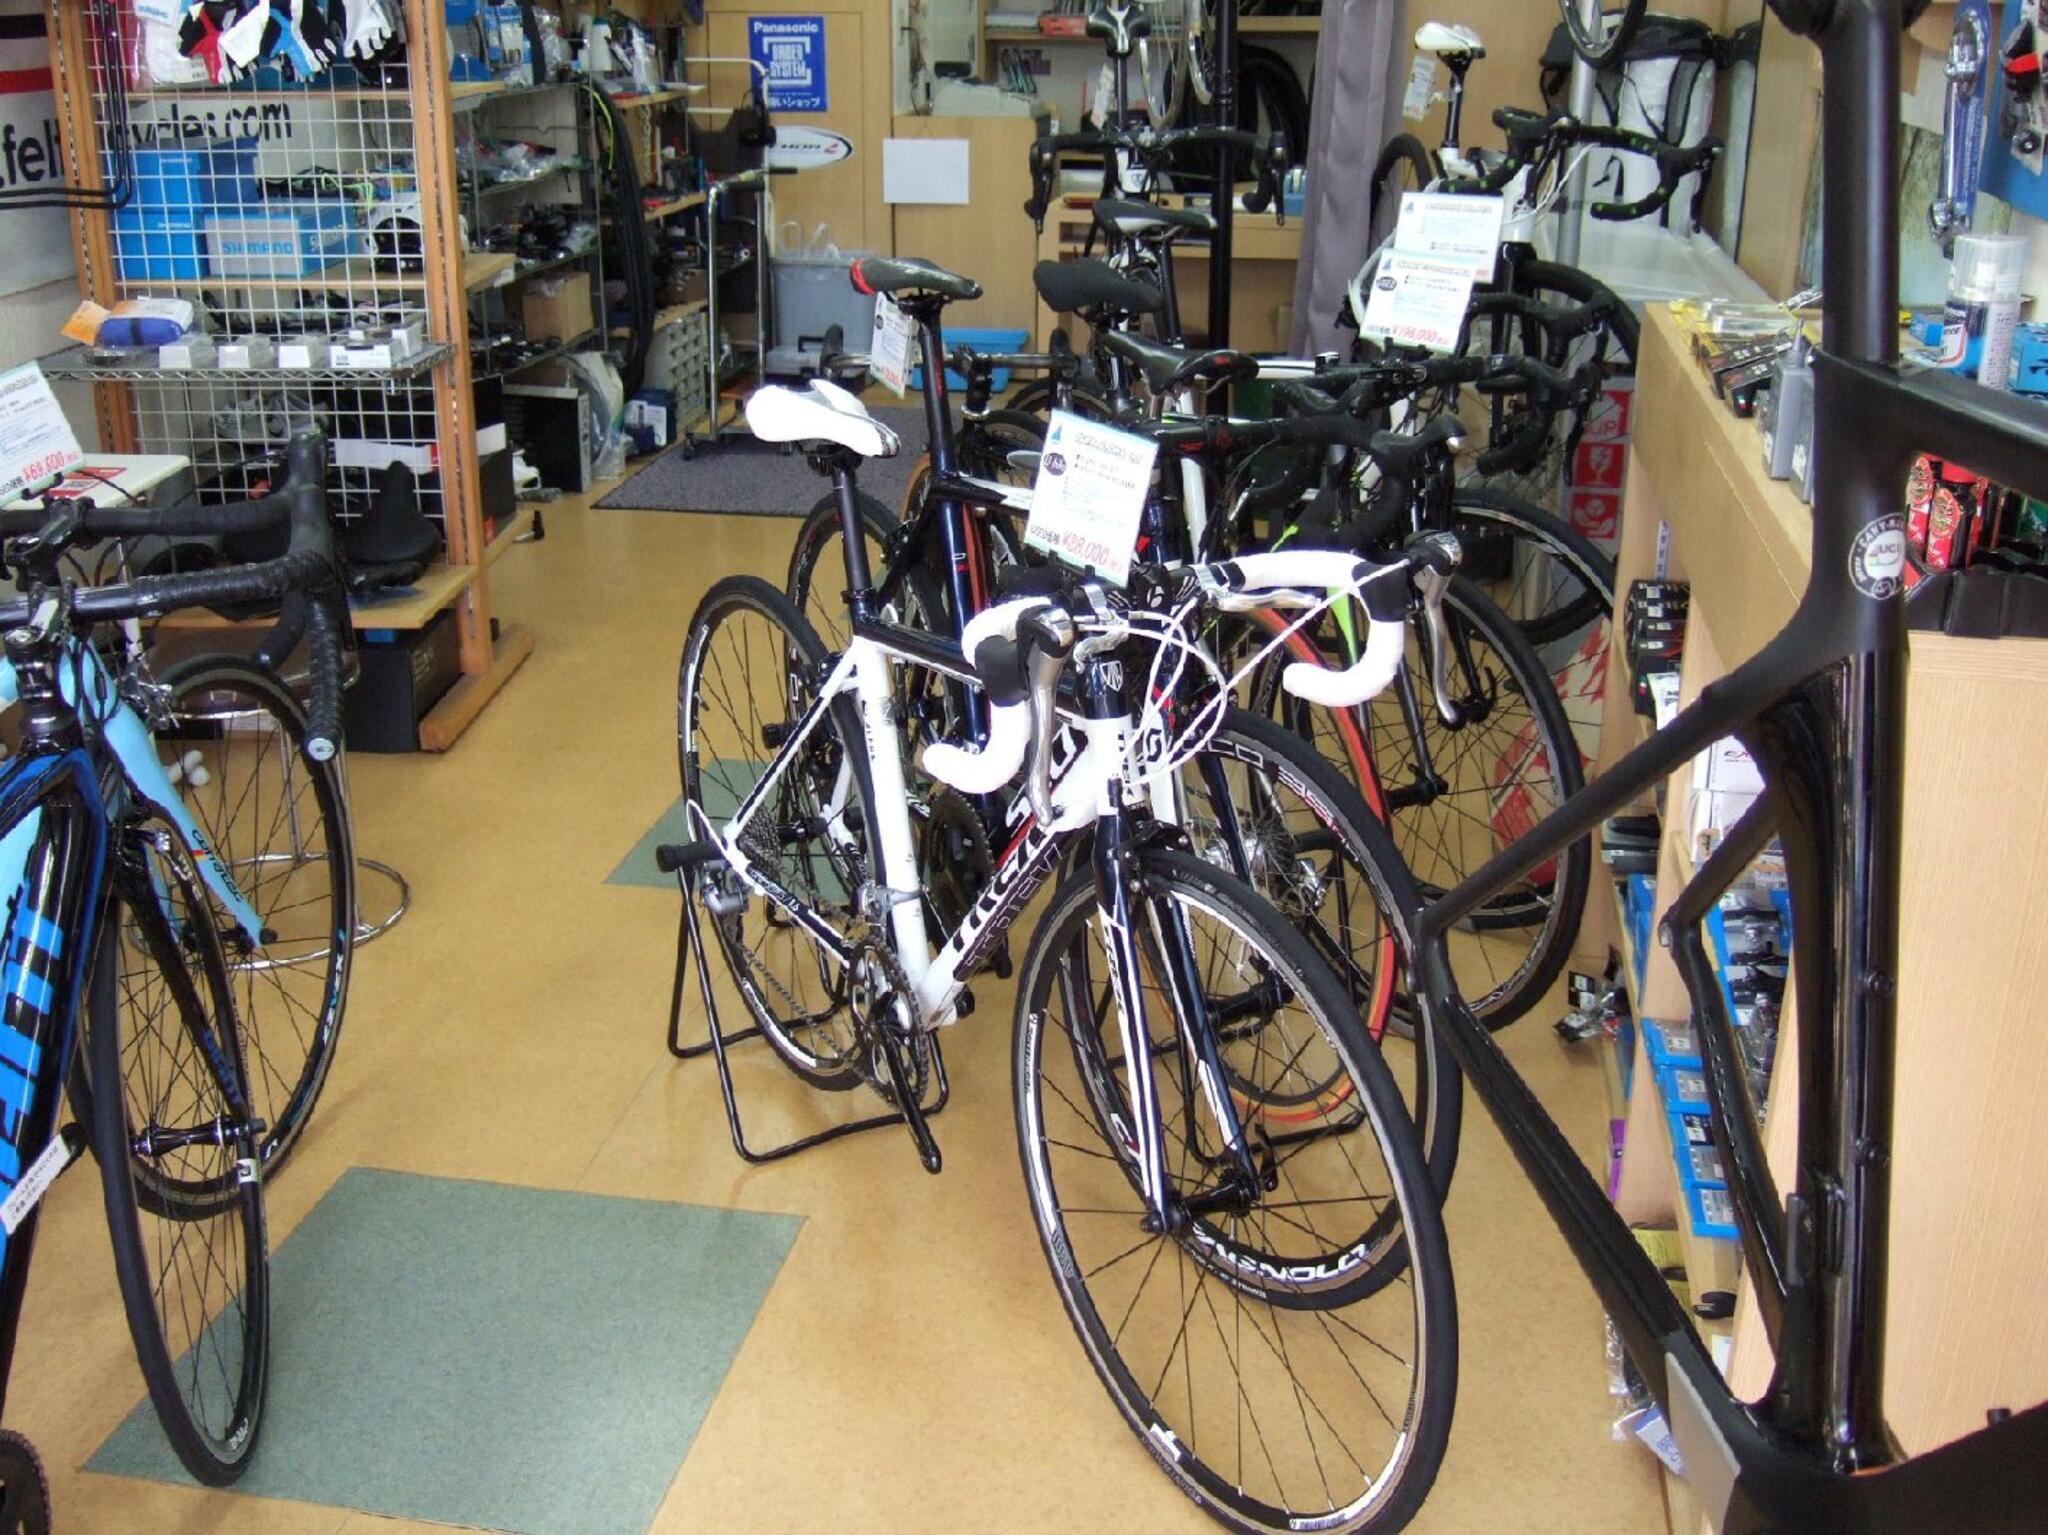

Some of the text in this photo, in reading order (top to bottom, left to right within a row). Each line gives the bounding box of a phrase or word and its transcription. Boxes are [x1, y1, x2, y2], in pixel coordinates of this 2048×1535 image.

[753, 21, 819, 33] Panasonic
[769, 61, 807, 78] SYSTEM
[223, 241, 294, 254] SHIMANO
[1879, 544, 1900, 553] UCI
